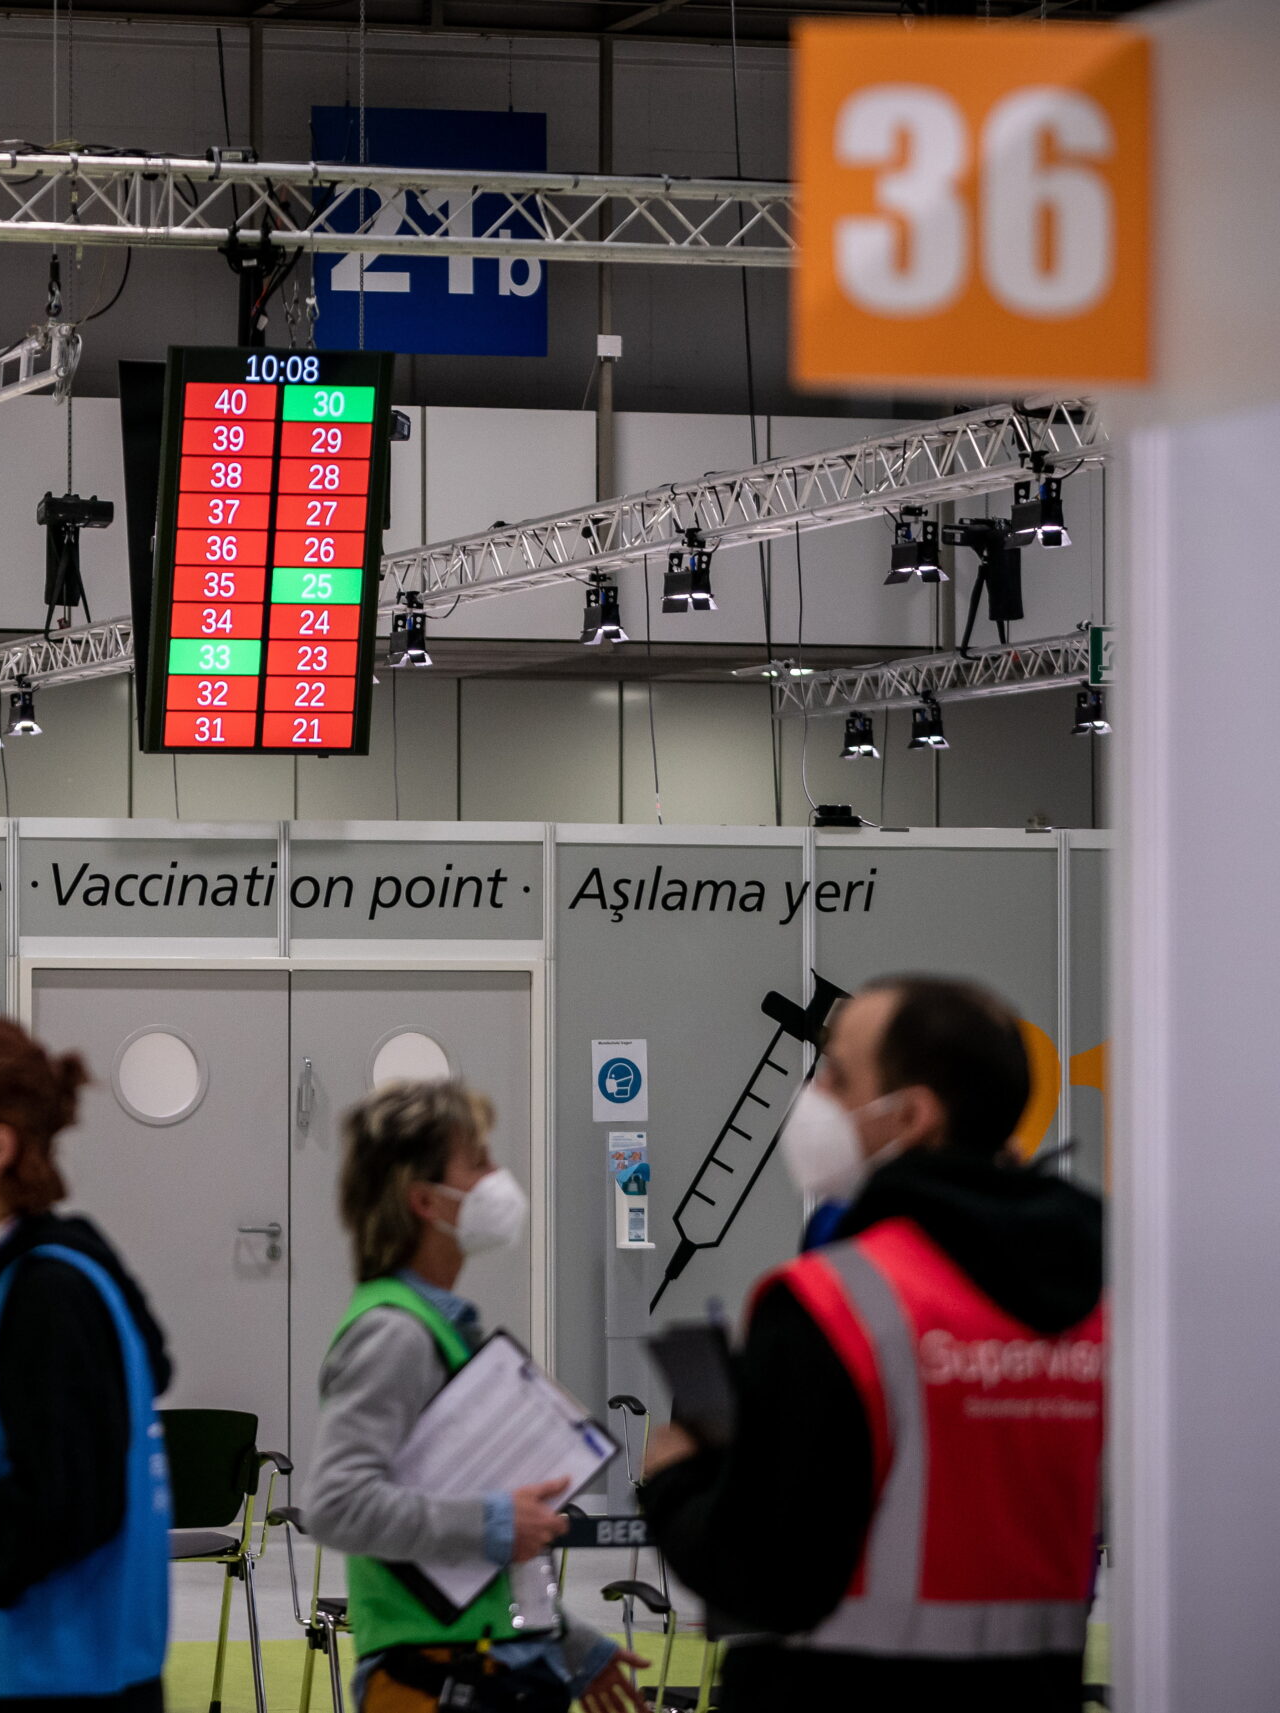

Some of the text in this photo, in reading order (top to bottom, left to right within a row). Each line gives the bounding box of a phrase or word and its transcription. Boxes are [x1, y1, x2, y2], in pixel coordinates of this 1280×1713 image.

[833, 82, 1116, 321] 36
[245, 355, 319, 383] 10:08
[214, 389, 247, 415] 40
[313, 391, 344, 417] 30
[212, 425, 244, 452] 39
[310, 427, 342, 454] 29
[210, 462, 242, 488] 38
[308, 464, 340, 490] 28
[208, 498, 240, 524] 37
[305, 500, 338, 526] 27
[205, 535, 237, 561] 36
[303, 537, 335, 563] 26
[203, 571, 235, 598] 35
[300, 572, 333, 599] 25
[201, 608, 233, 634] 34
[299, 609, 330, 635] 24
[198, 644, 231, 670] 33
[296, 645, 328, 671] 23
[196, 680, 228, 706] 32
[294, 681, 326, 707] 22
[194, 716, 225, 742] 31
[292, 717, 322, 743] 21
[51, 861, 354, 909] Vaccination
[368, 863, 508, 921] point
[568, 865, 878, 926] Aşılama yeri
